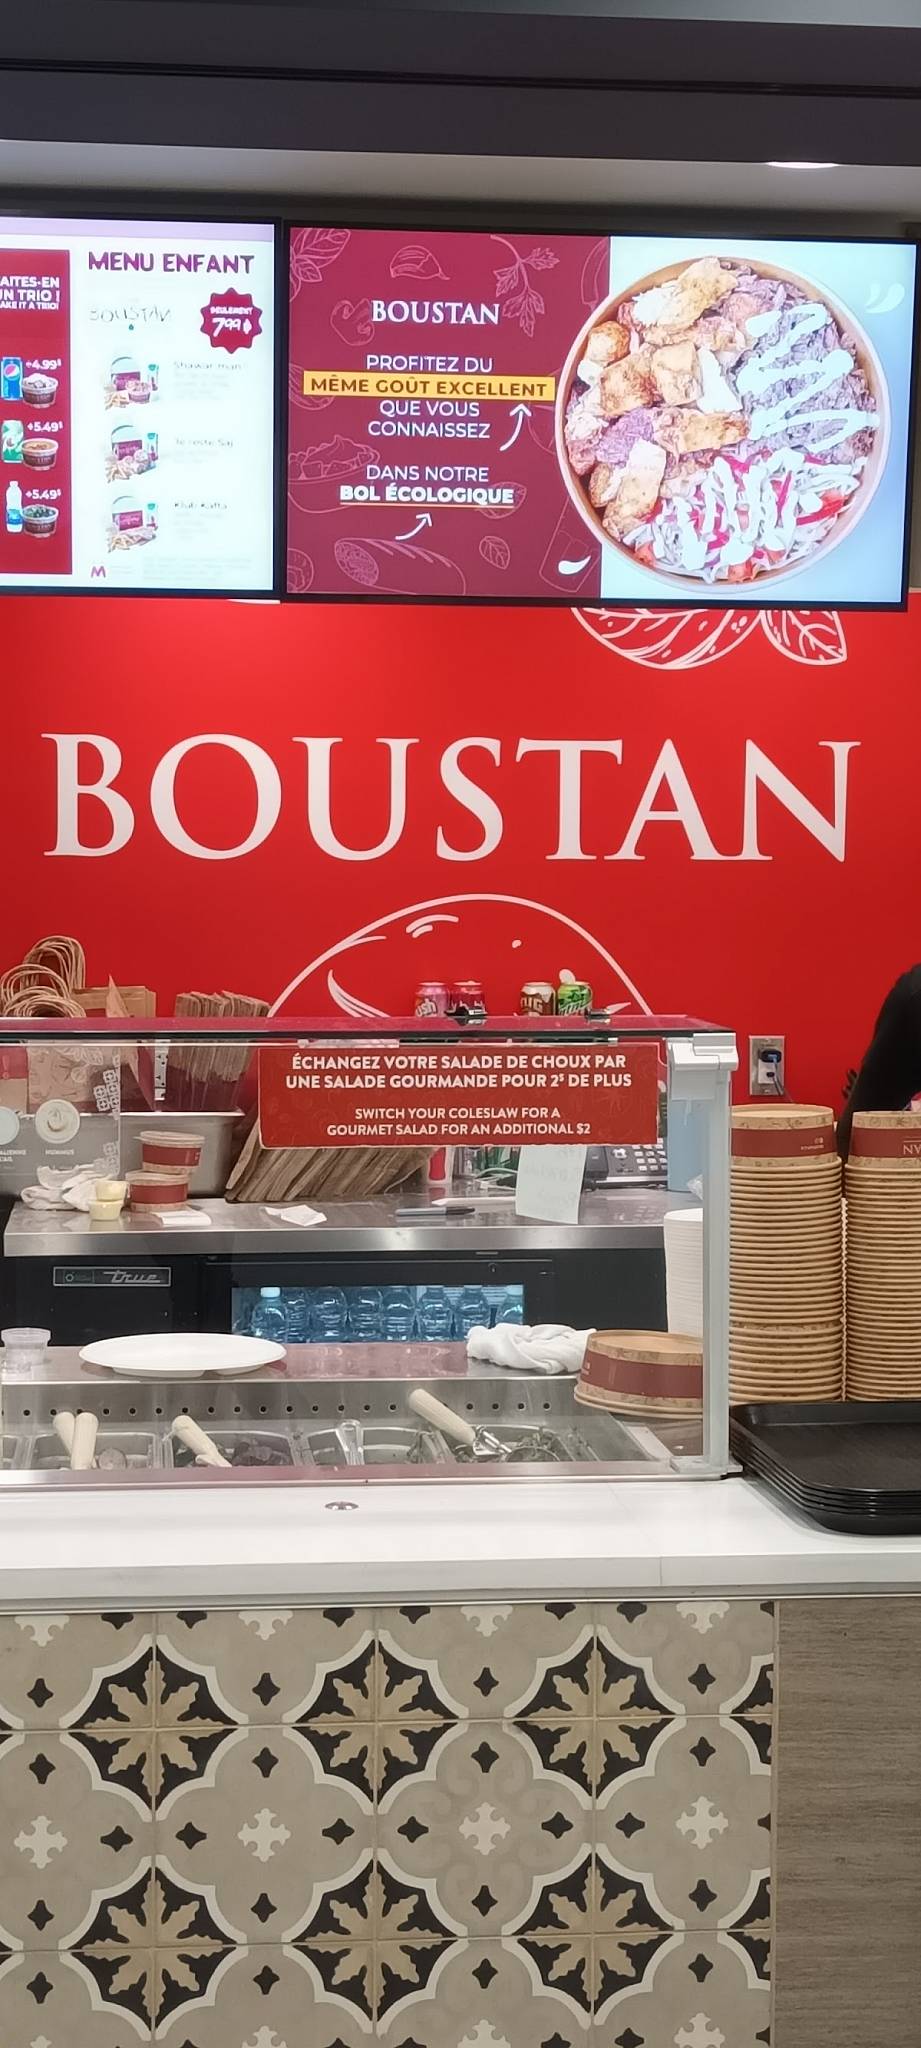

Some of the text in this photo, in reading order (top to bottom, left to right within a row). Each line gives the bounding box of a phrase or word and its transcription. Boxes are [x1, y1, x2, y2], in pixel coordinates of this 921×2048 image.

[88, 251, 255, 274] MENU ENFANT
[0, 276, 60, 288] AITES-EN
[18, 290, 52, 302] TRIO
[0, 301, 17, 309] AKE
[28, 302, 35, 310] A
[371, 300, 500, 325] BOUSTAN
[366, 355, 493, 373] PROFITEZ DU
[311, 374, 547, 397] MÊME GOÛT EXCELLENT
[380, 400, 480, 417] QUE VOUS
[368, 421, 490, 438] CONNAISSEZ
[366, 465, 489, 482] DANS NOTRE
[340, 482, 514, 504] BOL ÉCOLOGIQUE
[41, 732, 861, 862] BOUSTAN
[292, 1053, 626, 1070] ÉCHANGEZ VOTRE SALADE DE CHOUX PAR
[286, 1075, 321, 1089] UNE
[324, 1075, 386, 1089] SALADE
[389, 1075, 498, 1088] GOURMANDE
[502, 1074, 546, 1088] POUR
[568, 1074, 589, 1088] DE
[594, 1074, 632, 1087] PLUS
[355, 1107, 560, 1120] SWITCH YOUR COLESLAW FOR A
[327, 1123, 591, 1136] GOURMET SALAD FOR AN ADDITIONAL $2
